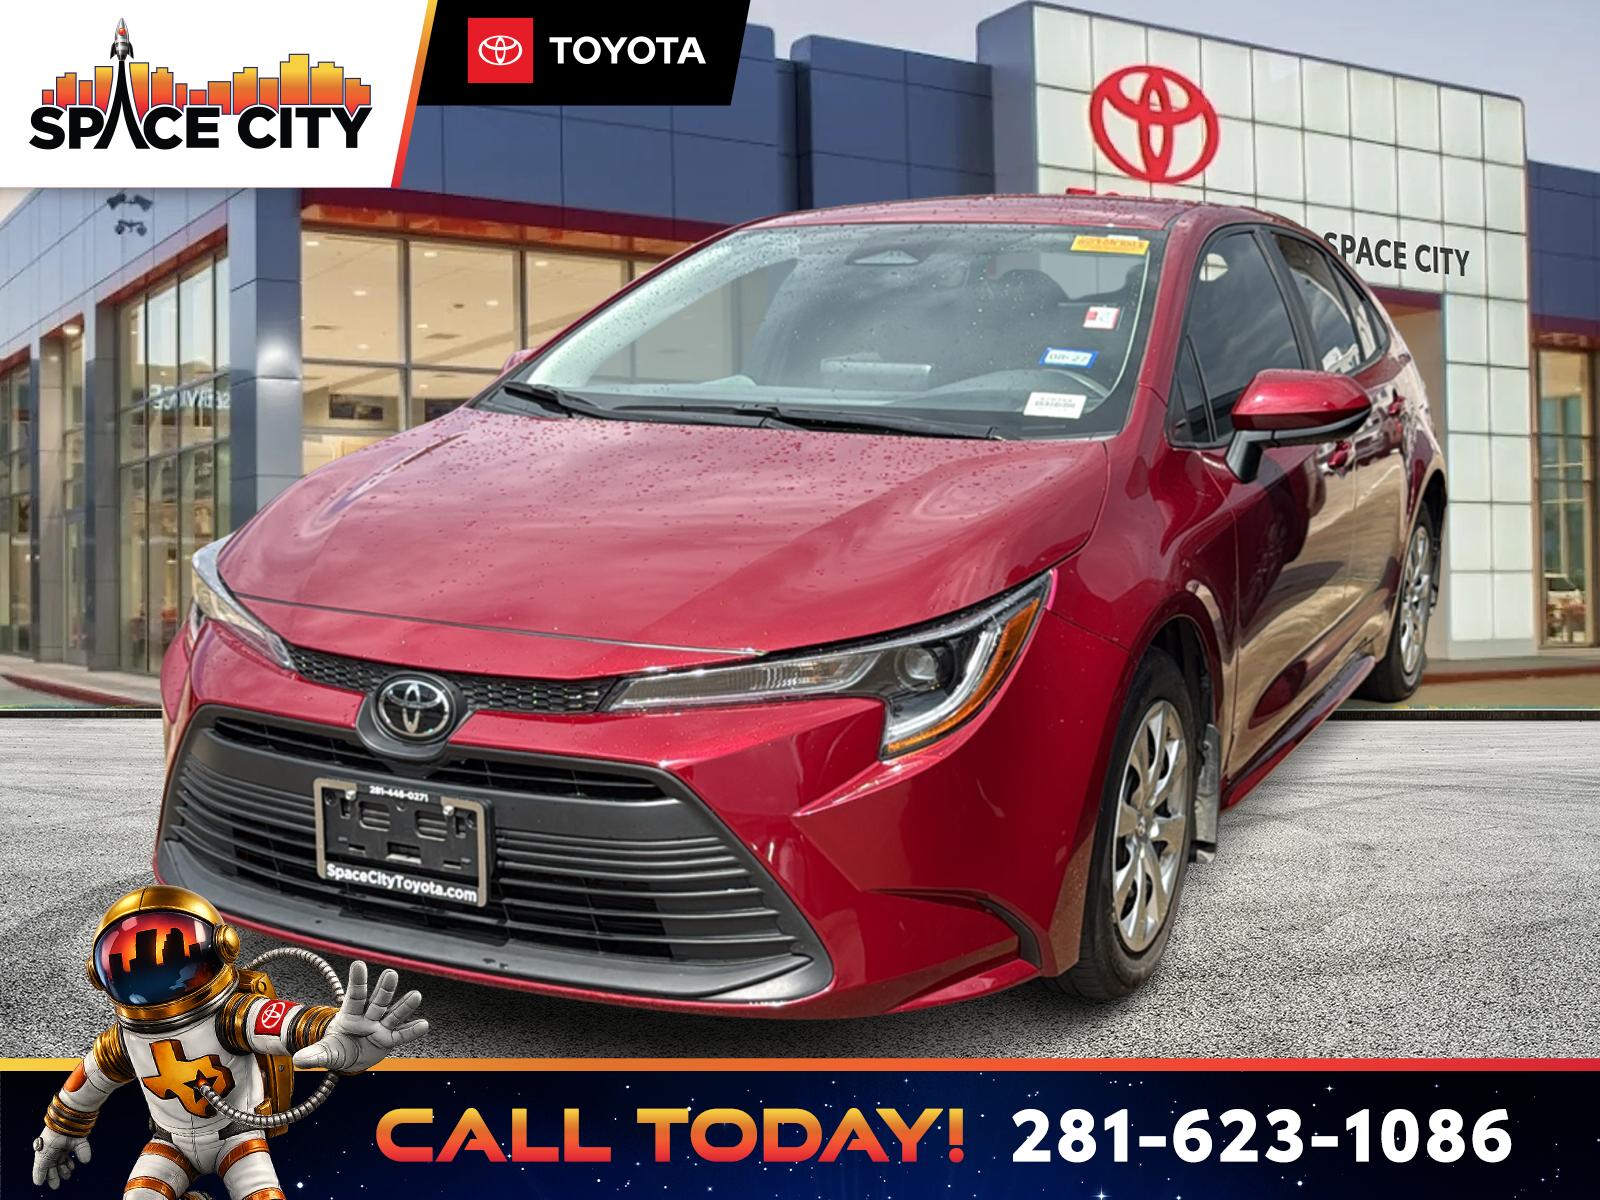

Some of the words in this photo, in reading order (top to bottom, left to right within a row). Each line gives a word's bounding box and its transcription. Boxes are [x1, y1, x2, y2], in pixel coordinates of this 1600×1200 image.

[1324, 232, 1407, 269] SPACE
[1415, 244, 1470, 276] CITY
[326, 862, 478, 903] SpaceCityToyota.com
